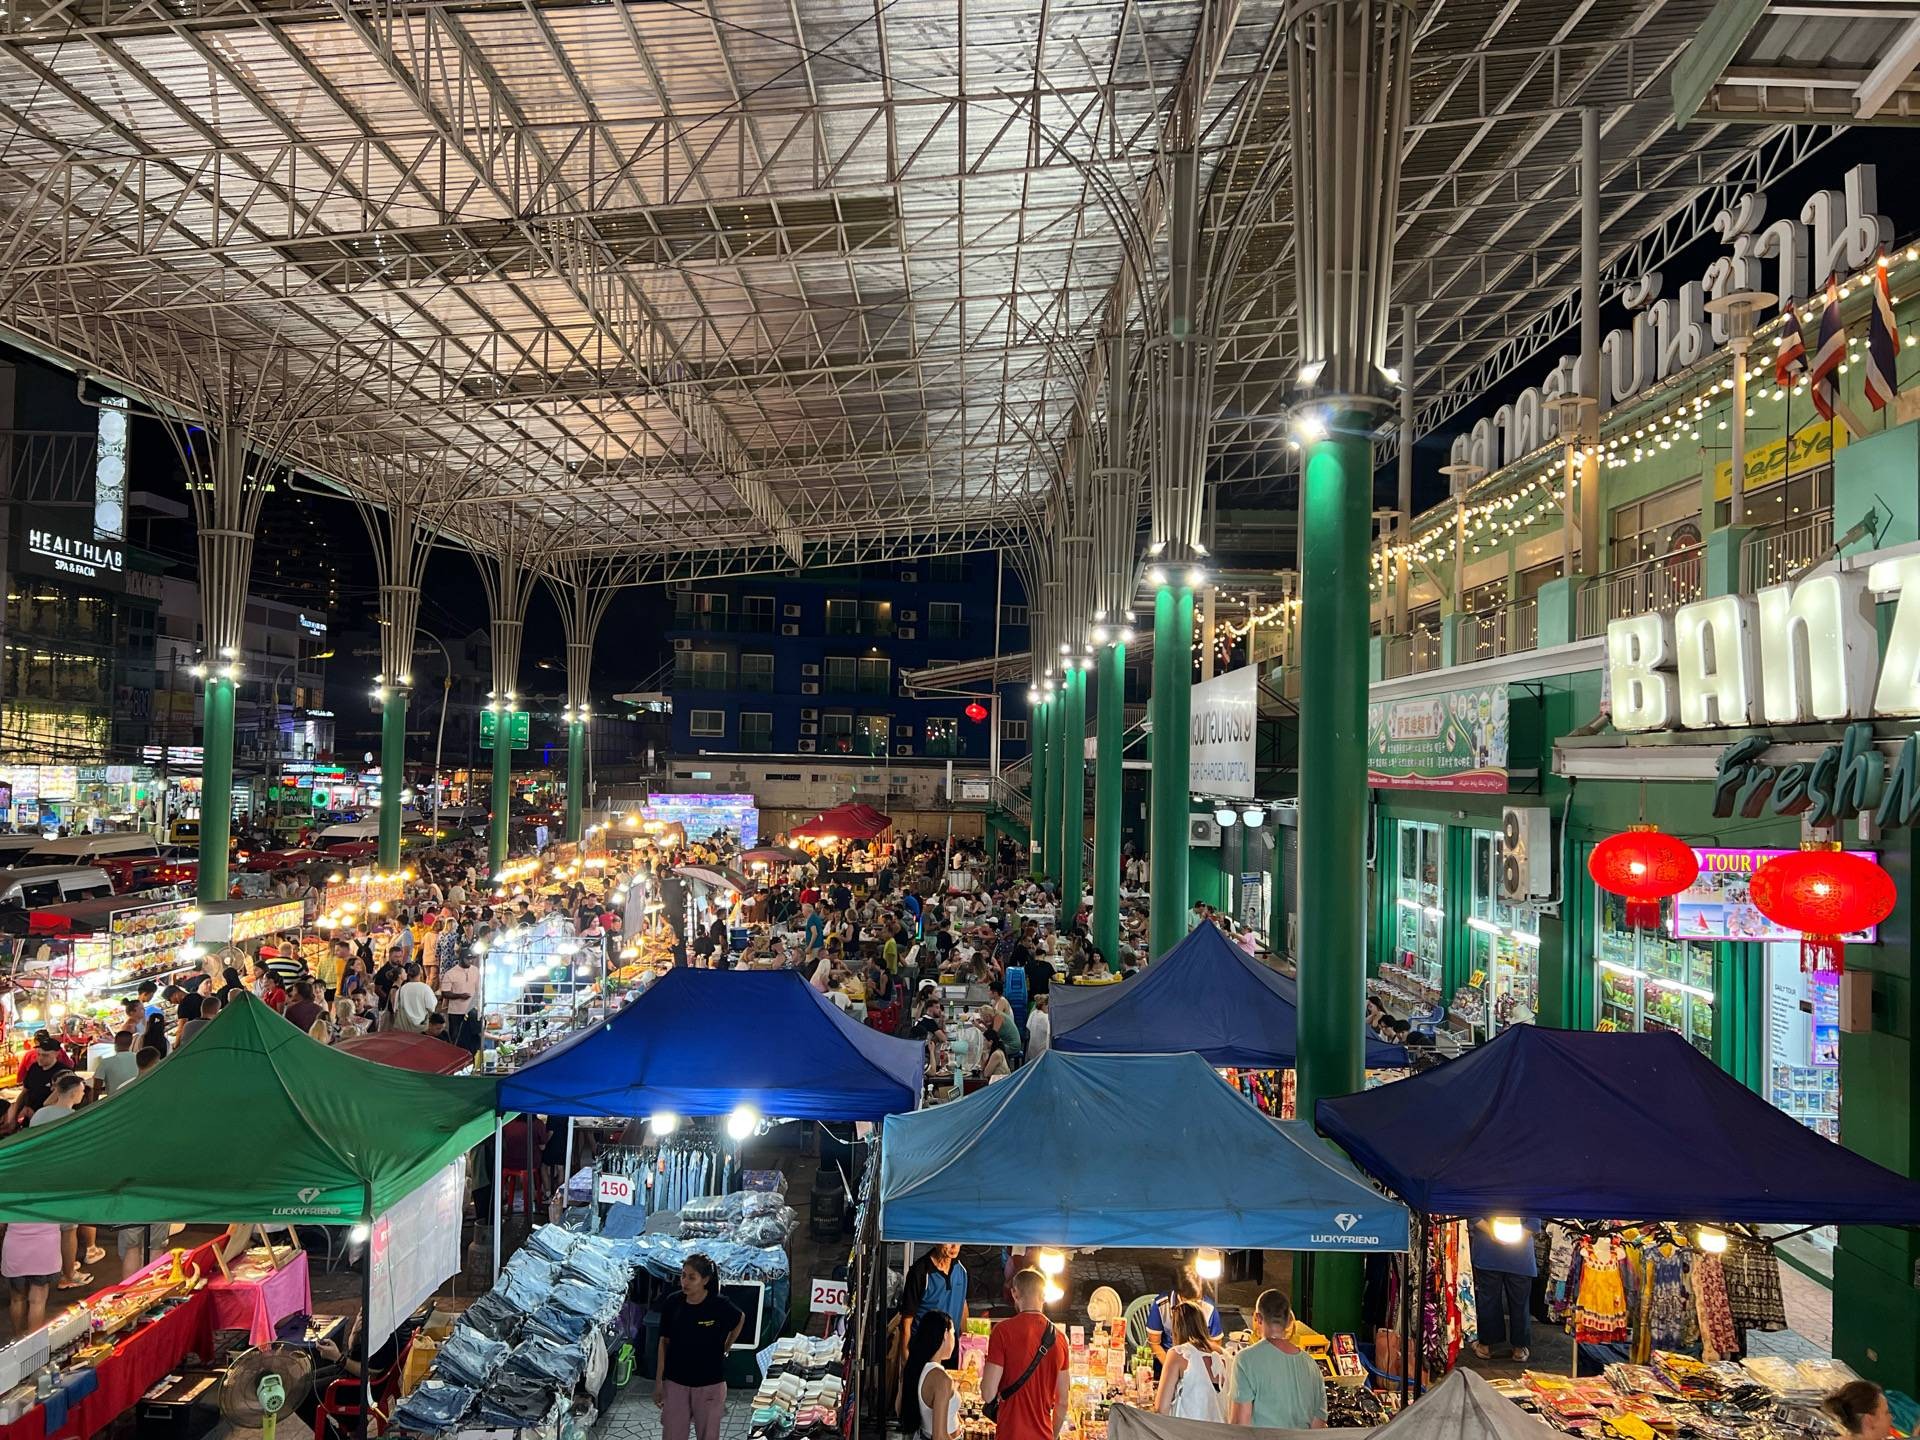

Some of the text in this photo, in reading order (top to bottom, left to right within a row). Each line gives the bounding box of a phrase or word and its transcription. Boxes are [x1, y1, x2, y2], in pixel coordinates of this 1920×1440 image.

[29, 529, 122, 567] HEALTHLAB
[55, 559, 68, 571] SPA
[69, 563, 75, 573] &
[1712, 723, 1884, 828] Fresh
[1705, 853, 1751, 872] TOUR
[601, 1181, 628, 1197] 150
[272, 1207, 342, 1215] LUCKYFRIEND
[1311, 1234, 1379, 1245] LUCKYFRIEND
[814, 1287, 847, 1305] 250
